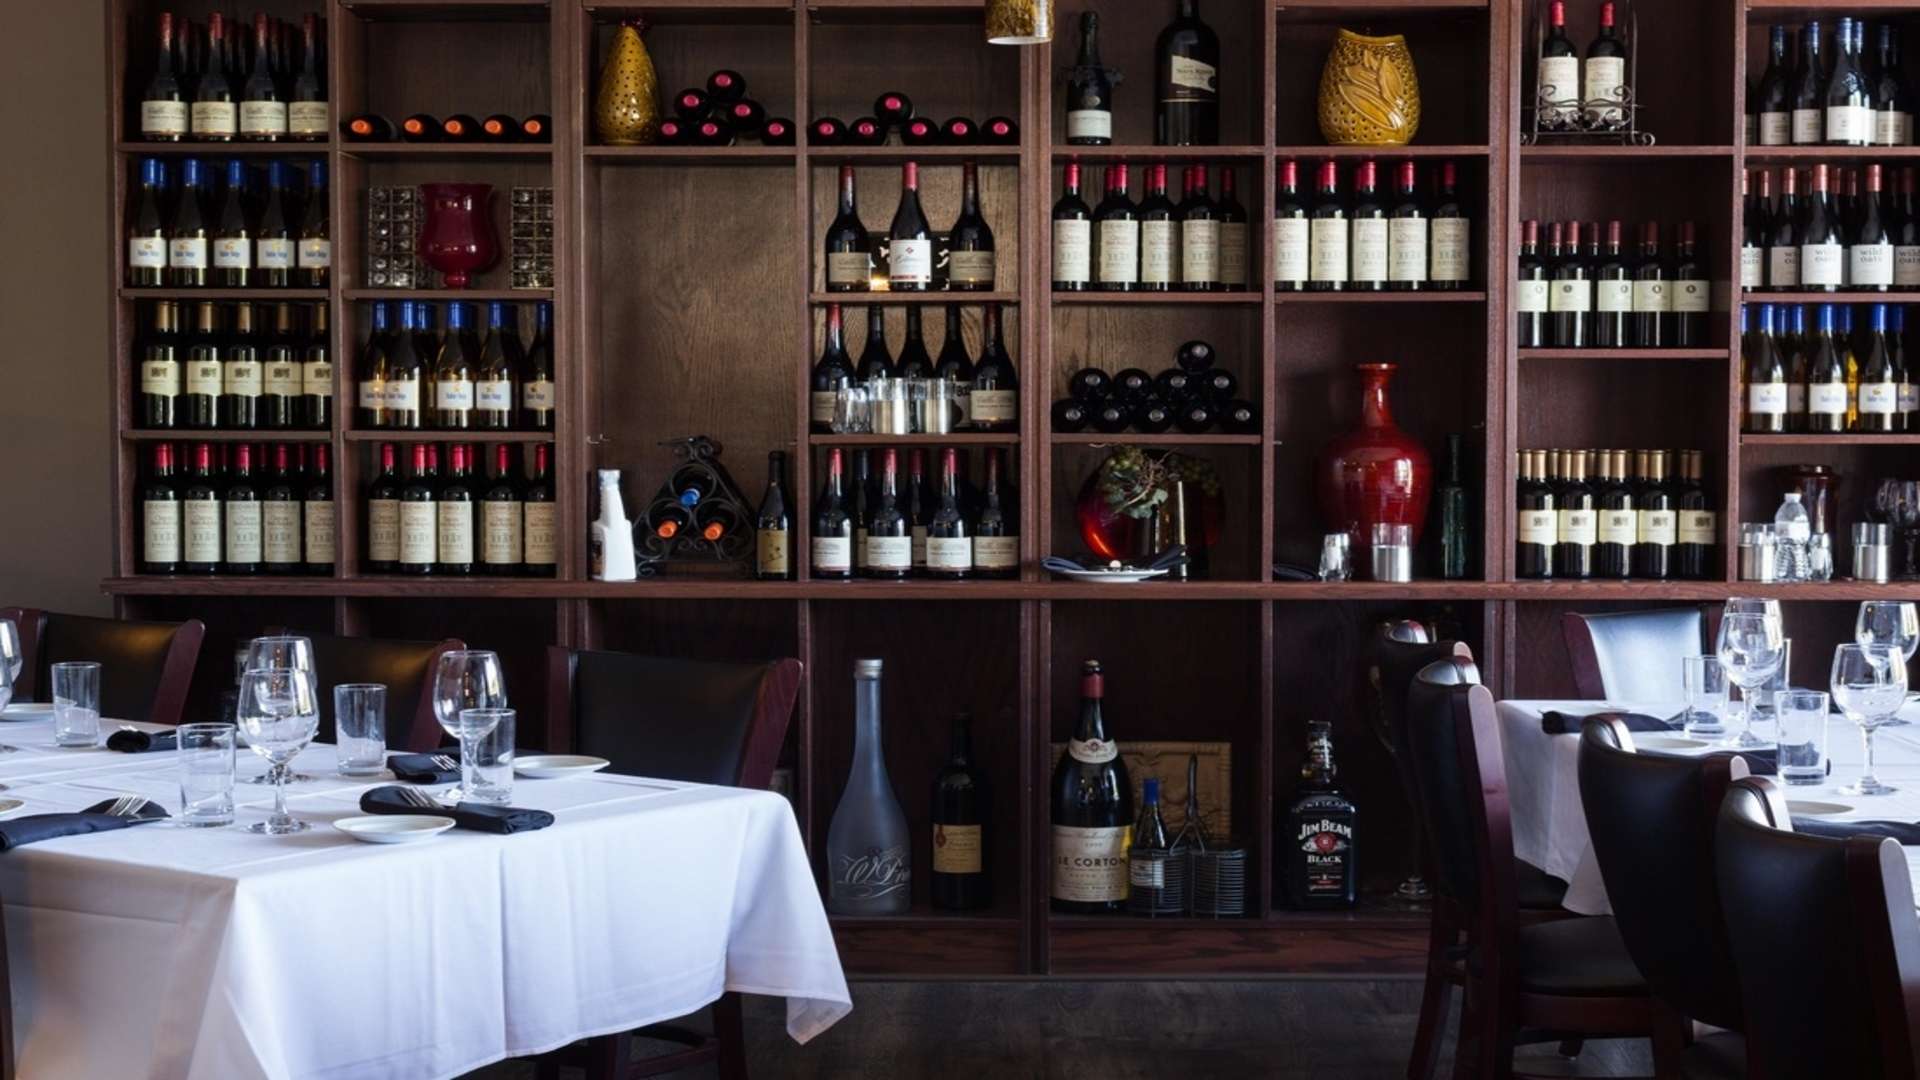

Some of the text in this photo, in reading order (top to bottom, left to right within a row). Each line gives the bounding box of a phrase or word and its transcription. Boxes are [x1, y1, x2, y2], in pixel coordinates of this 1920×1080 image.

[1860, 247, 1882, 256] wild
[1297, 819, 1352, 841] JIM BEAM
[1307, 854, 1342, 863] BLACK
